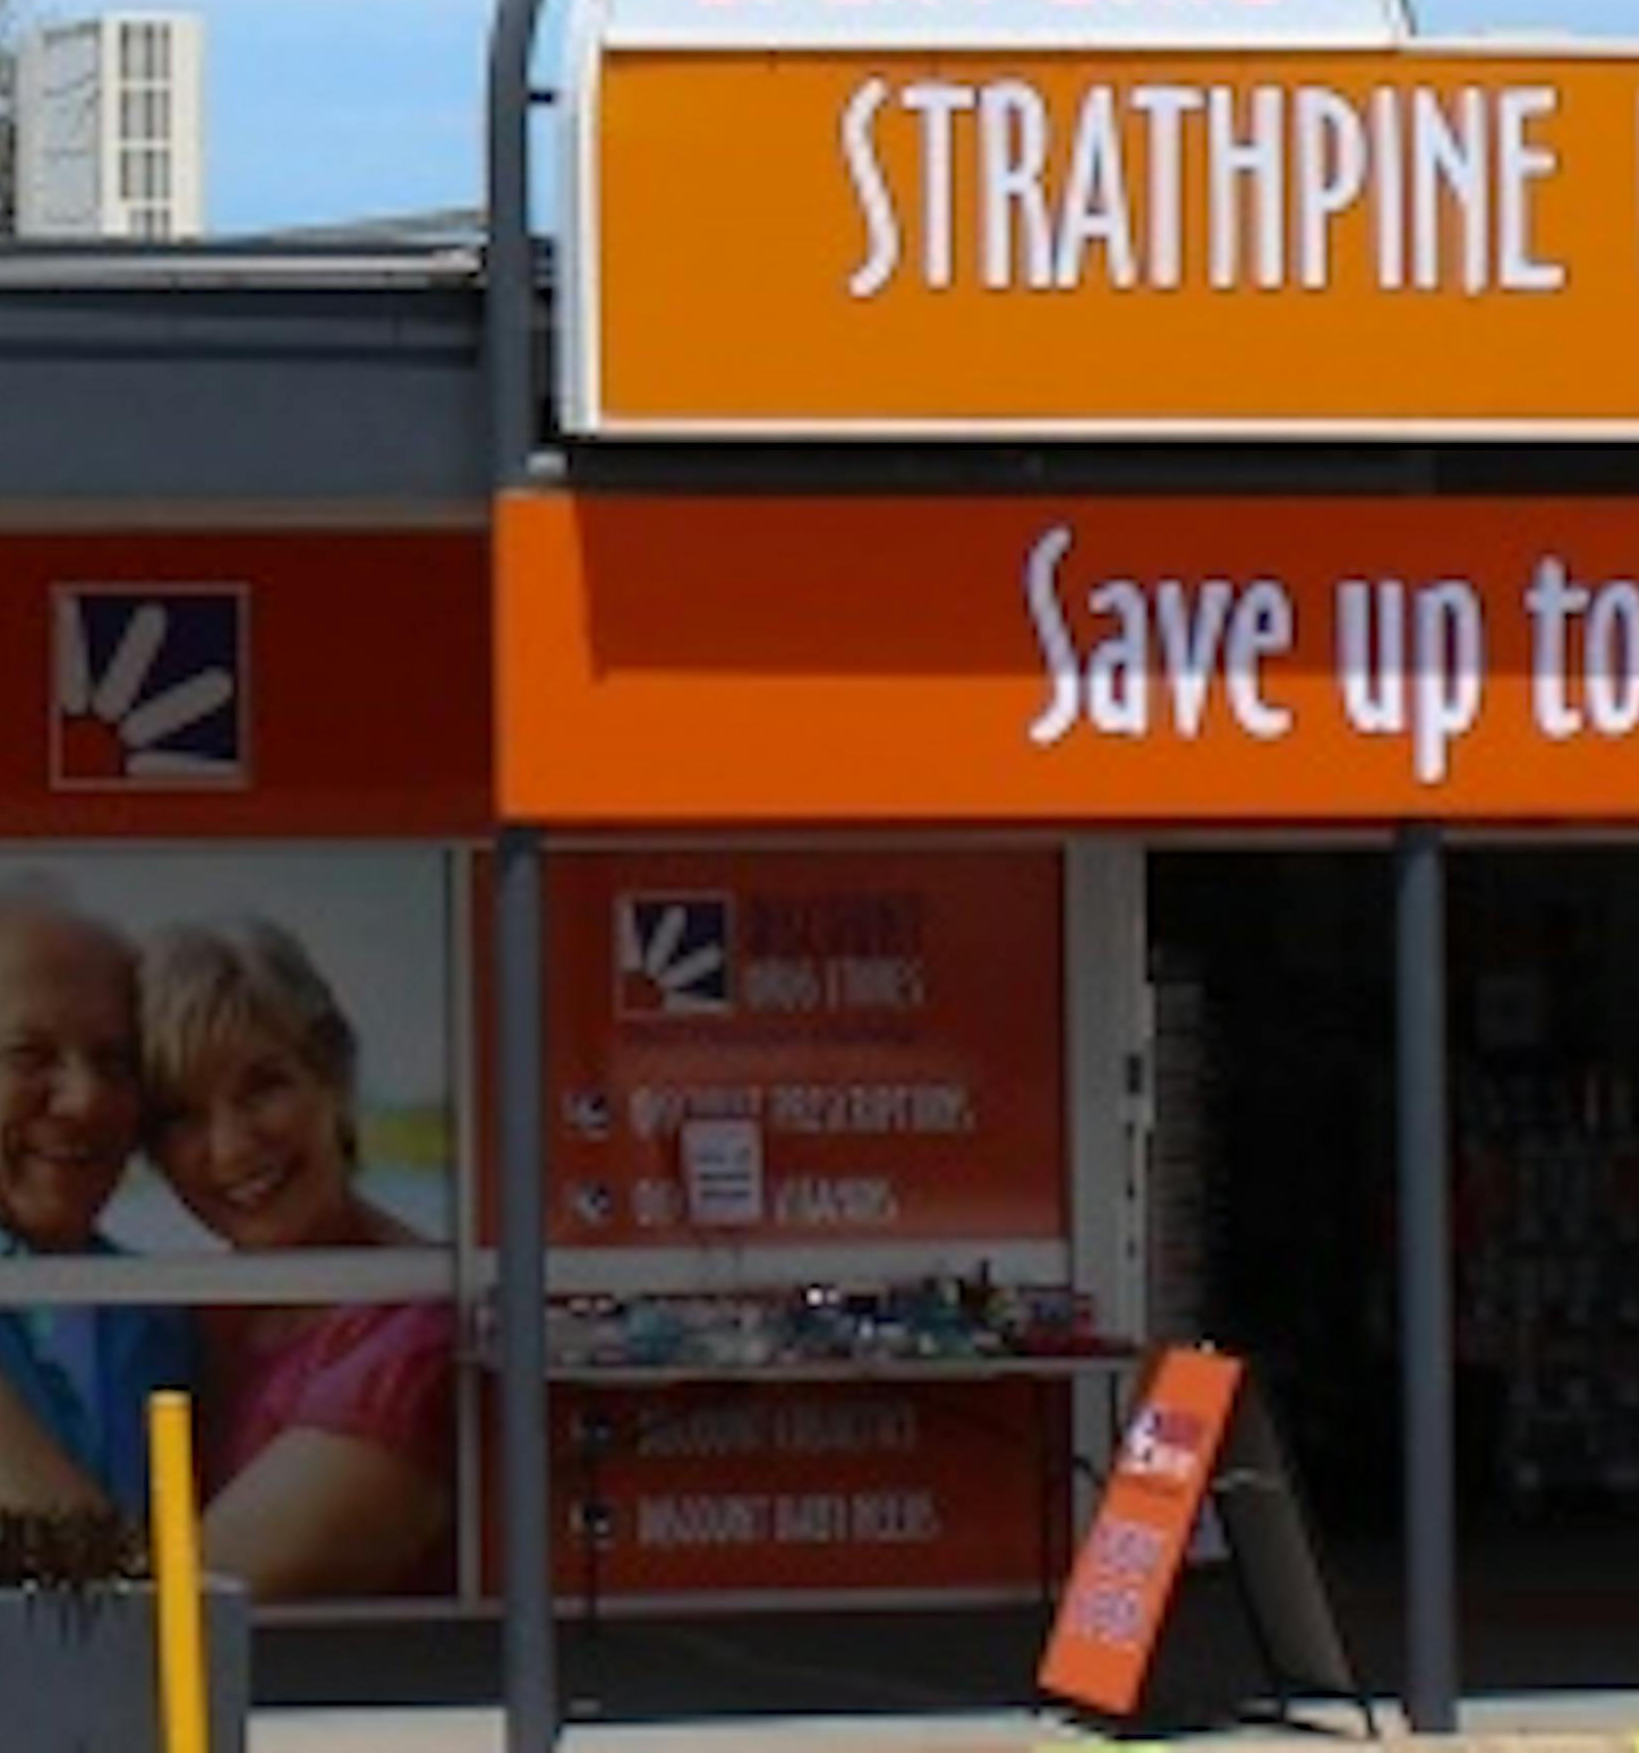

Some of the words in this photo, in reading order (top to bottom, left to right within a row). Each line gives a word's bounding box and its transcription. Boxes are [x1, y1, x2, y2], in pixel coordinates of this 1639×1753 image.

[840, 79, 1563, 299] STRATHPINE
[1025, 524, 1292, 745] Save
[1339, 573, 1483, 786] up
